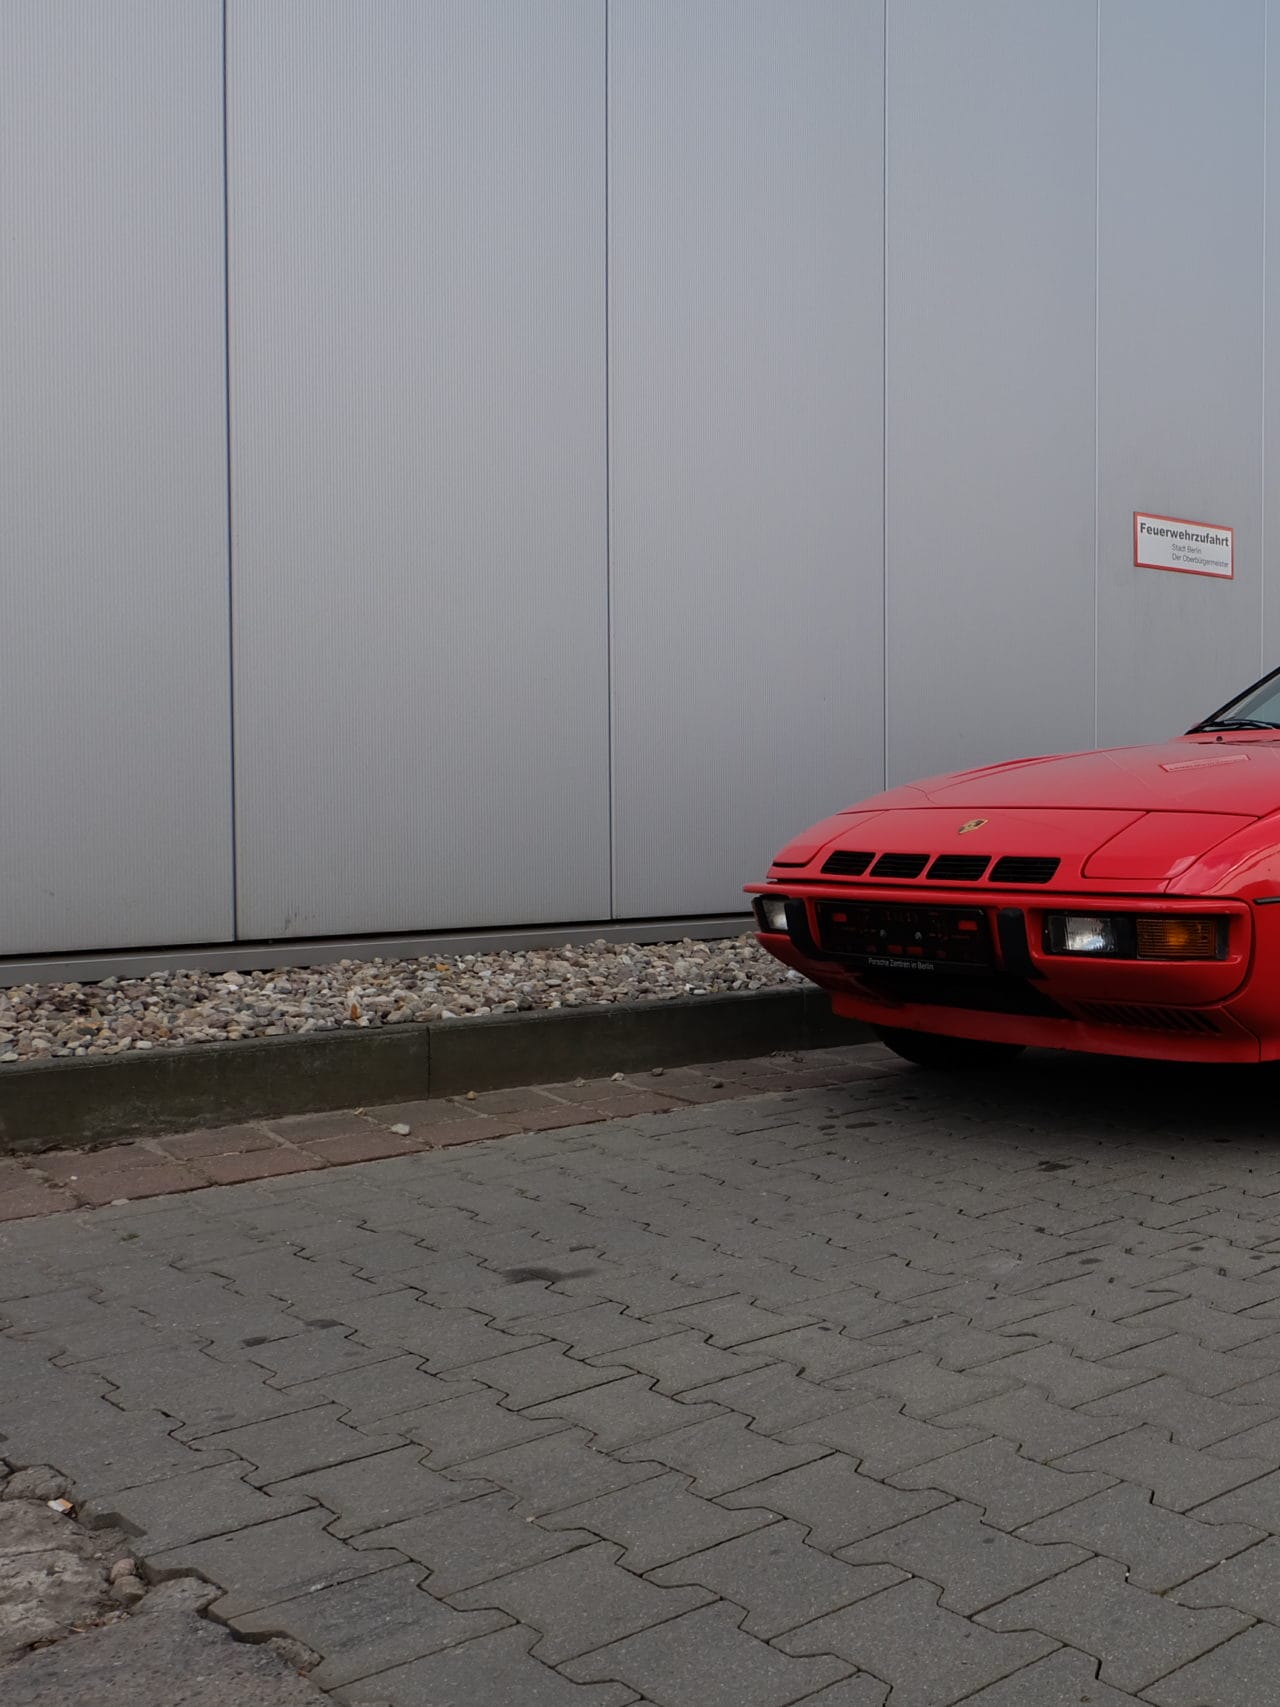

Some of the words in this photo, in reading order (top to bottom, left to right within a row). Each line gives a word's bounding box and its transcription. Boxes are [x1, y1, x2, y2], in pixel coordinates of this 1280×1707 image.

[1140, 522, 1229, 547] Feuerwehrzufahrt
[1187, 545, 1202, 554] Berlin
[1171, 553, 1182, 561] Der
